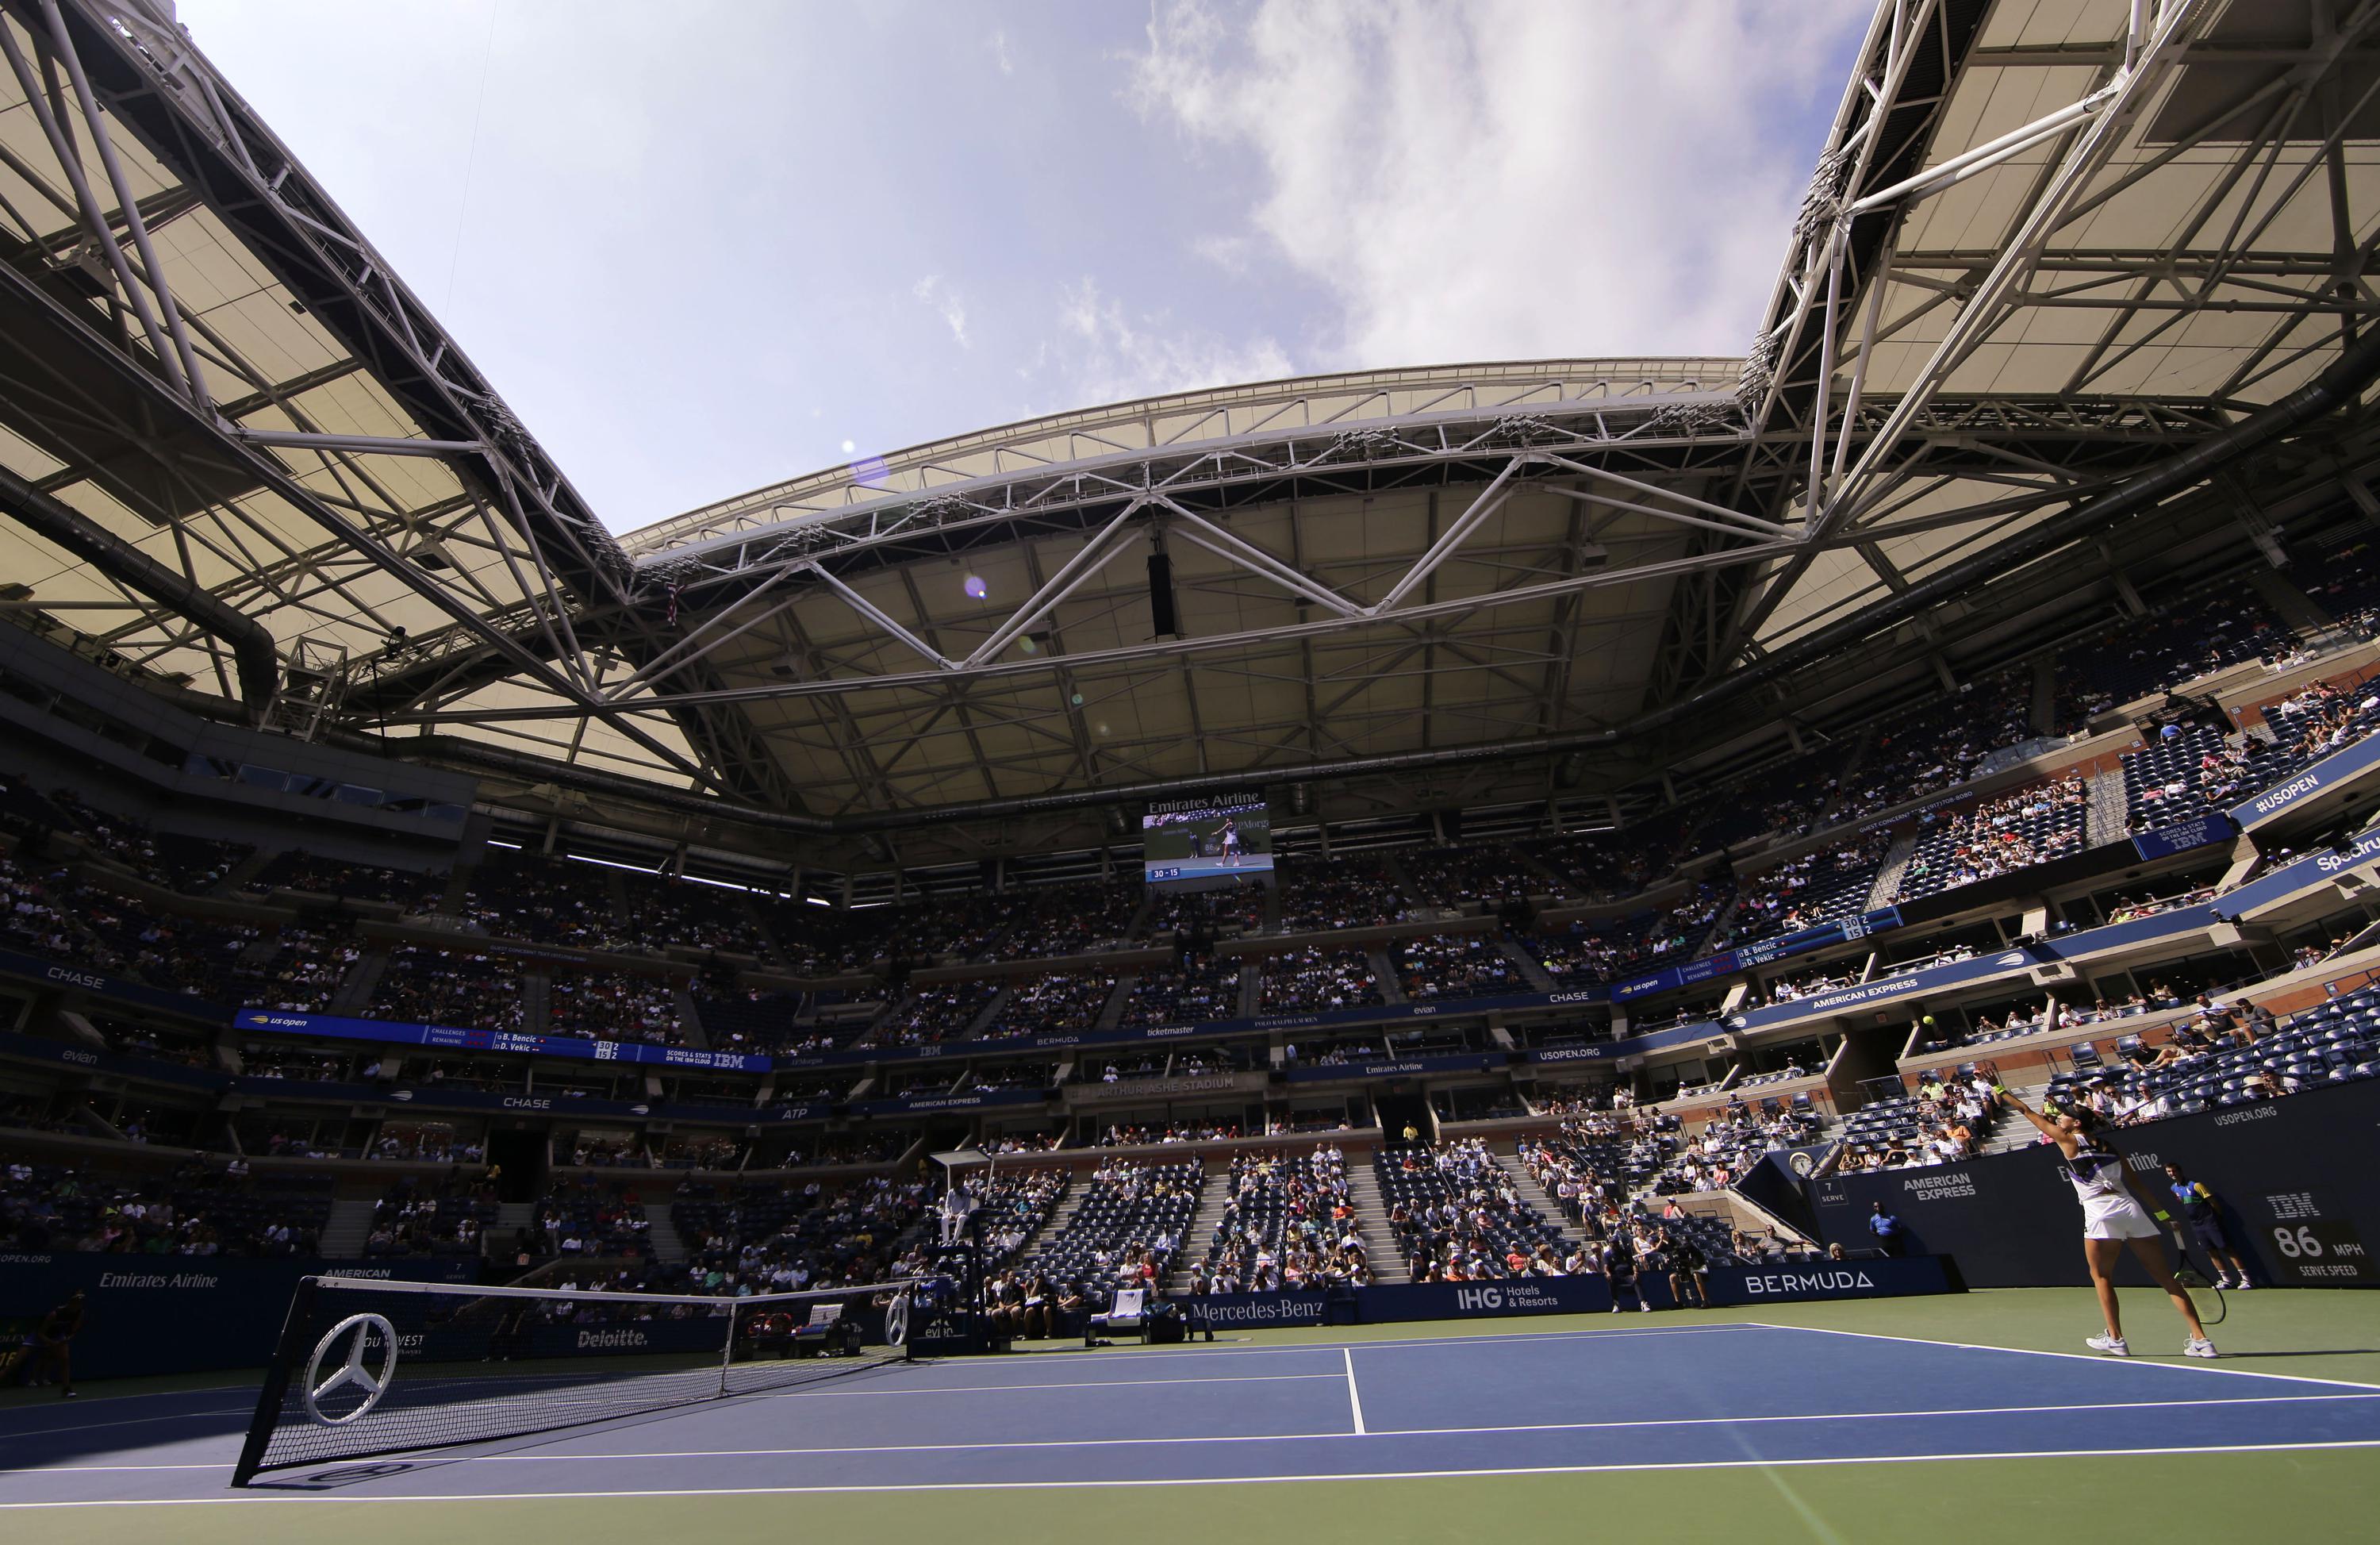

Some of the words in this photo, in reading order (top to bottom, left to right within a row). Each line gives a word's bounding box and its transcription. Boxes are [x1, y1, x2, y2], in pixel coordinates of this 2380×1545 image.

[2255, 774, 2319, 813] #USOPEN
[1150, 798, 1208, 813] Emirates
[1212, 792, 1259, 807] Airline
[1859, 823, 1878, 833] GUEST
[2159, 827, 2182, 836] SCORES
[2187, 821, 2205, 830] STATS
[2171, 832, 2208, 850] IBM
[1844, 918, 1858, 928] 30
[1849, 928, 1860, 938] 15
[1865, 925, 1872, 934] 2
[1752, 941, 1777, 955] Bencic
[1755, 953, 1775, 963] Vekic
[1682, 960, 1712, 973] CHALLENGES
[48, 967, 106, 990] CHASE
[1687, 970, 1713, 981] REMAINING
[1549, 991, 1589, 1004] CHASE
[1813, 990, 1865, 1009] AMERICAN
[1868, 978, 1918, 998] EXPRESS
[1414, 1005, 1436, 1015] evian
[432, 1028, 466, 1036] CHALLENGES
[1147, 1025, 1194, 1036] ticketmaster
[512, 1034, 537, 1043] Bencic
[1037, 1035, 1080, 1047] BERMUDA
[510, 1043, 531, 1052] Vekic
[919, 1045, 942, 1057] IBM
[1540, 1047, 1600, 1061] USOPEN.ORG
[62, 1049, 98, 1065] evian
[714, 1053, 745, 1069] IBM
[1365, 1063, 1396, 1074] Emirates
[1399, 1061, 1423, 1072] Airline
[1097, 1086, 1143, 1098] ARTHUR
[1149, 1082, 1179, 1093] ASHE
[1182, 1078, 1234, 1090] STADIUM
[503, 1097, 551, 1109] CHASE
[909, 1099, 946, 1109] AMERICAN
[948, 1097, 981, 1106] EXPRESS
[782, 1108, 808, 1120] ATP
[2214, 1105, 2277, 1127] USOPEN.ORG
[2127, 1151, 2162, 1172] rline
[1825, 1182, 1832, 1191] 7
[1904, 1172, 1971, 1190] AMERICAN
[1821, 1194, 1844, 1203] SERVE
[1916, 1185, 1976, 1201] EXPRESS
[2266, 1192, 2321, 1219] IBM
[2274, 1226, 2323, 1258] 86
[2332, 1243, 2365, 1256] MPH
[0, 1254, 52, 1263] OPEN.ORG
[324, 1269, 391, 1278] AMERICAN
[2299, 1266, 2327, 1277] SERVE
[2327, 1265, 2358, 1276] SPEED
[98, 1271, 167, 1289] Emirates
[170, 1273, 218, 1289] Airline
[1745, 1270, 1874, 1294] BERMUDA
[1507, 1286, 1540, 1297] Hotels
[1457, 1288, 1502, 1309] IHG
[1509, 1298, 1517, 1307] &
[1518, 1294, 1558, 1307] Resorts
[1192, 1299, 1324, 1321] Mercedes-Benz
[364, 1336, 381, 1347] OU
[578, 1329, 648, 1348] Deloitte.
